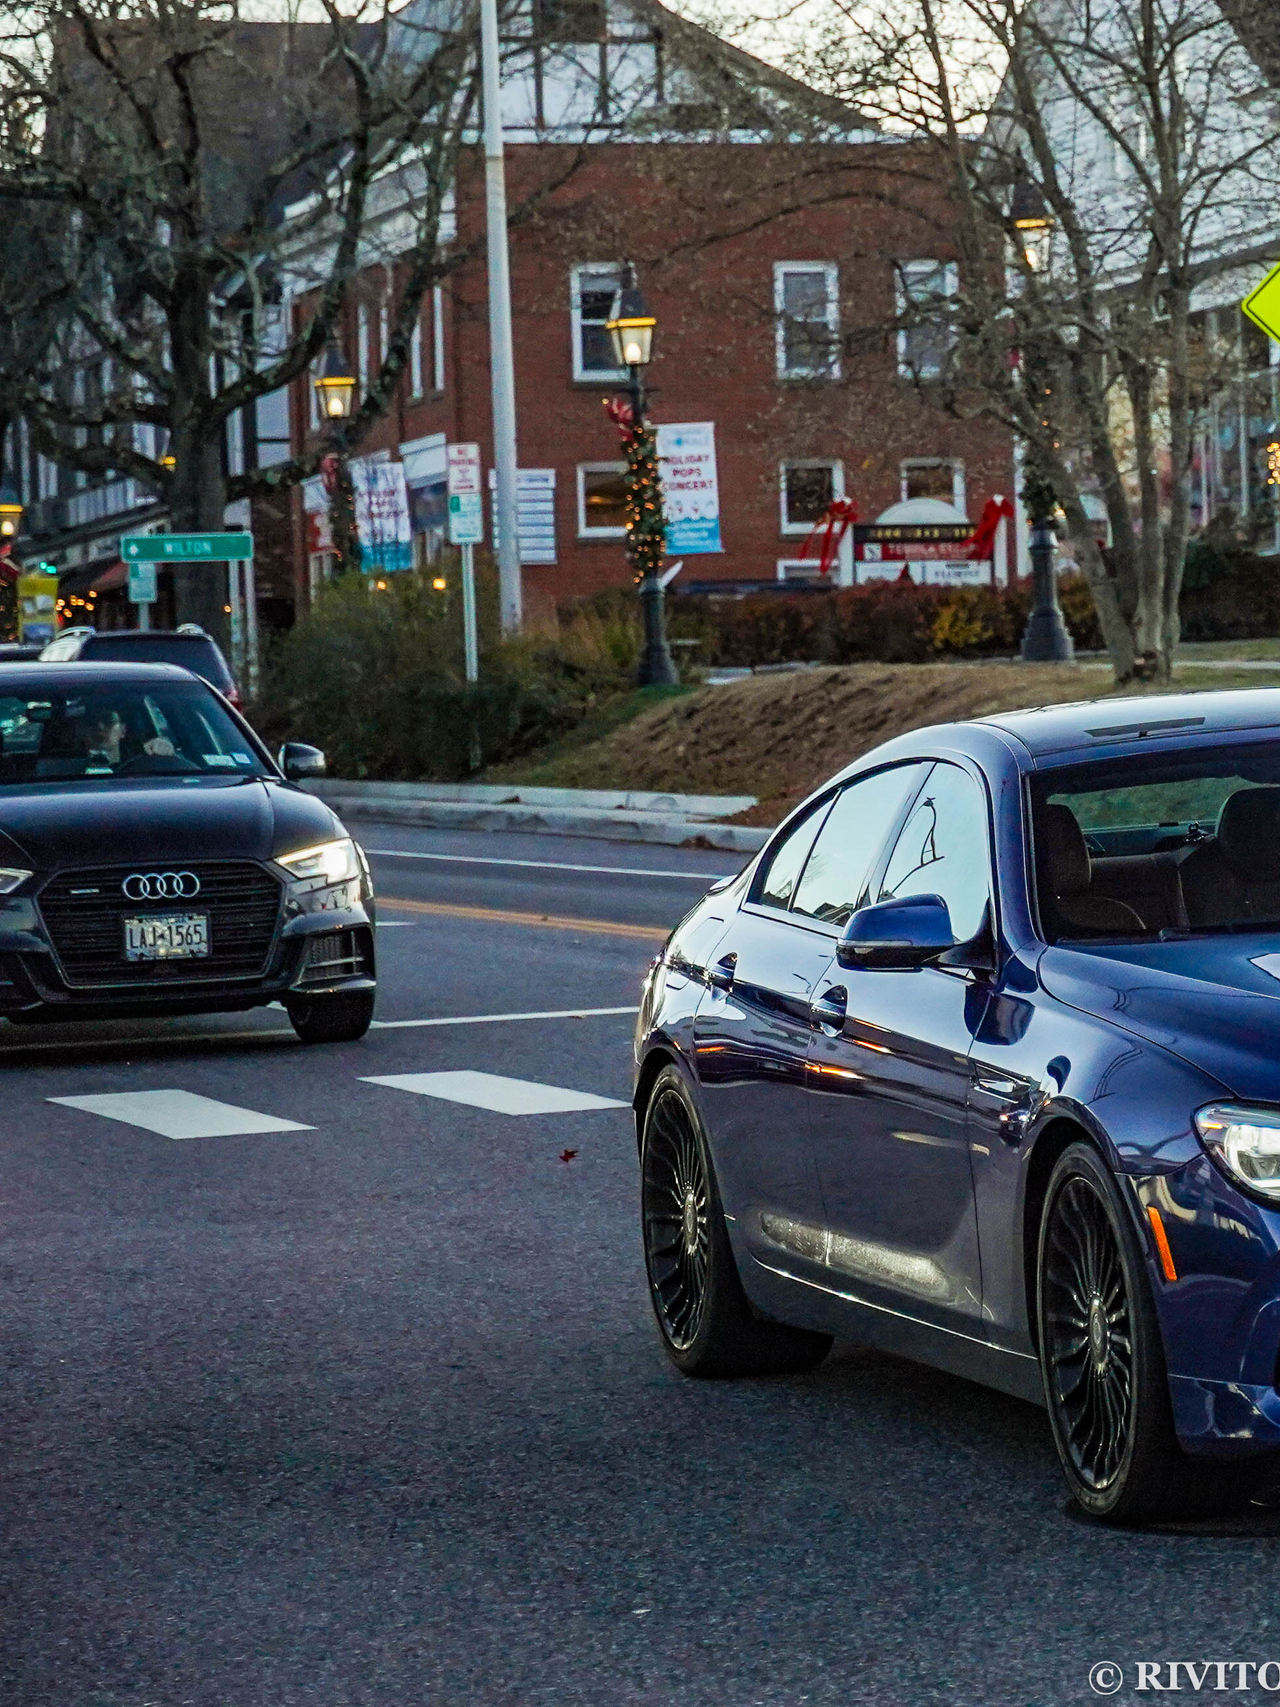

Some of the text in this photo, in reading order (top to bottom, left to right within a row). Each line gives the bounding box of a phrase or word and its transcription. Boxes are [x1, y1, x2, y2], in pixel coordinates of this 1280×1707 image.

[672, 467, 702, 478] POPS
[164, 540, 212, 556] WILTON
[167, 923, 204, 947] 1565
